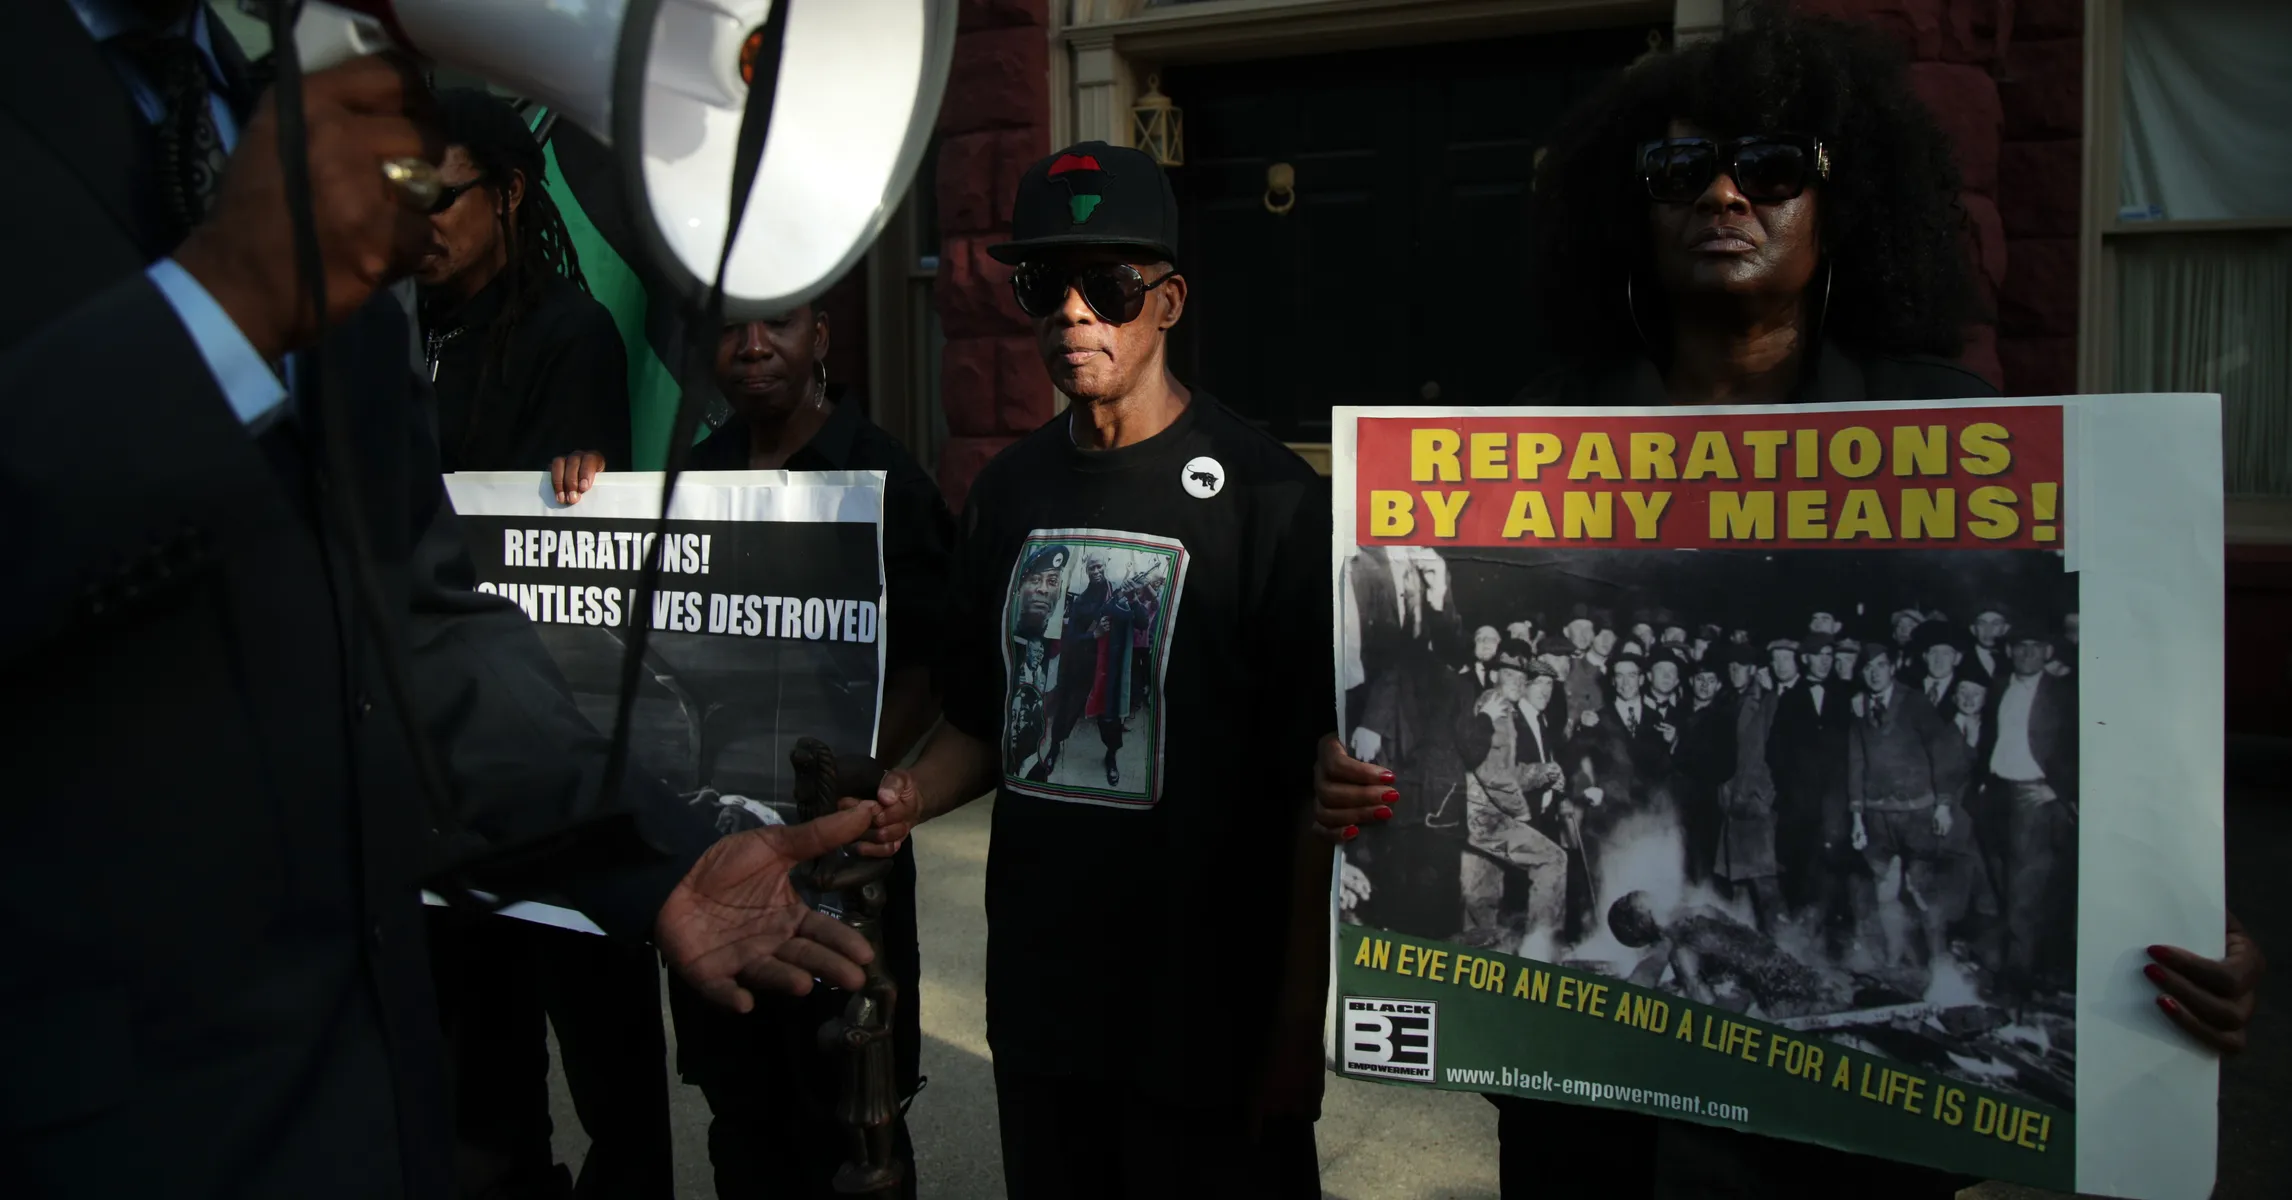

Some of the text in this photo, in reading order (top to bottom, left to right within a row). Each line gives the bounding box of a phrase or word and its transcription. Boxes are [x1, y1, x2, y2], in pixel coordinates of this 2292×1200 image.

[1411, 422, 2012, 482] REPARATIONS
[1369, 482, 2059, 542] BY ANY MEANS!
[628, 588, 703, 633] VES
[708, 593, 877, 644] DESTROYED
[1349, 1001, 1432, 1015] BLACK
[1346, 1014, 1430, 1065] BE
[1354, 936, 2052, 1153] AN EYE FOR AN EYE AND A LIFE FOR A LIFE IS DUE!
[1347, 1061, 1431, 1077] EMPOWERMENT
[1445, 1066, 1750, 1123] www.black-empowerment.com
